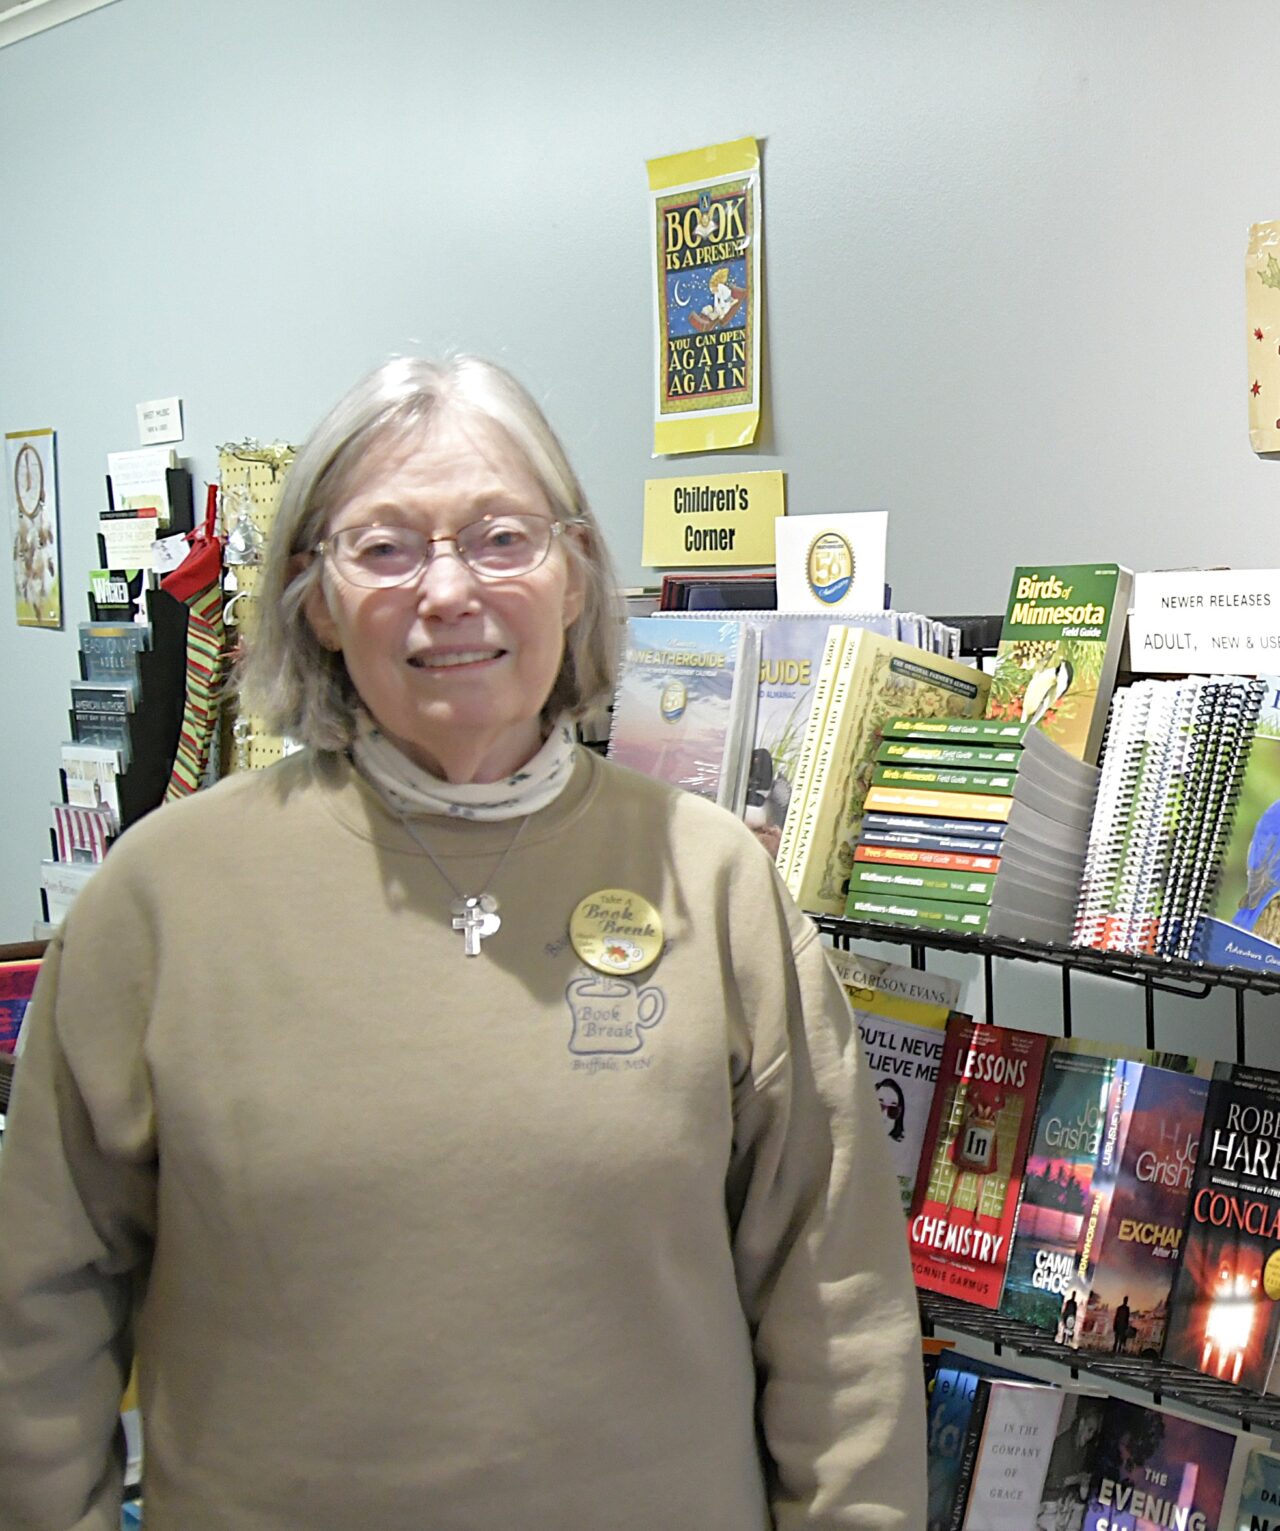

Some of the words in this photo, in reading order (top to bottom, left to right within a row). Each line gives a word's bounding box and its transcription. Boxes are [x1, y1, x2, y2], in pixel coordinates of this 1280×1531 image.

[701, 196, 709, 208] A
[666, 197, 745, 252] BOOK
[666, 253, 680, 269] IS
[682, 249, 694, 267] A
[696, 240, 745, 265] PRESENT
[669, 338, 690, 351] YOU
[696, 334, 716, 347] CAN
[720, 330, 746, 343] OPEN
[669, 341, 746, 371] AGAIN
[669, 367, 745, 395] AGAIN
[674, 484, 748, 513] Children's
[684, 525, 736, 552] Corner
[1016, 574, 1064, 599] Birds
[1061, 586, 1073, 600] of
[1010, 600, 1105, 625] Minnesota
[1161, 596, 1204, 609] NEWER
[1210, 594, 1271, 607] RELEASES
[1062, 627, 1079, 637] Field
[1080, 628, 1101, 637] Guide
[1144, 633, 1198, 652] ADULT,
[1211, 636, 1240, 649] NEW
[1246, 636, 1254, 649] &
[583, 904, 633, 921] Book
[599, 919, 655, 938] Break
[853, 970, 909, 993] CARLSON
[910, 985, 945, 1003] EVANS
[579, 1006, 621, 1022] Book
[583, 1022, 633, 1039] Break
[915, 1064, 940, 1082] ME
[954, 1049, 1028, 1088] LESSONS
[967, 1130, 988, 1158] In
[1103, 1107, 1120, 1166] Grisham
[912, 1215, 1003, 1266] CHEMISTRY
[1078, 1210, 1098, 1277] EXCHANGE
[949, 1272, 990, 1295] GARMUS
[1003, 1423, 1014, 1433] IN
[1018, 1424, 1039, 1435] THE
[992, 1445, 1041, 1458] COMPANY
[1004, 1468, 1018, 1478] OF
[1144, 1468, 1168, 1487] THE
[990, 1488, 1023, 1500] GRACE
[1097, 1478, 1207, 1531] EVENING
